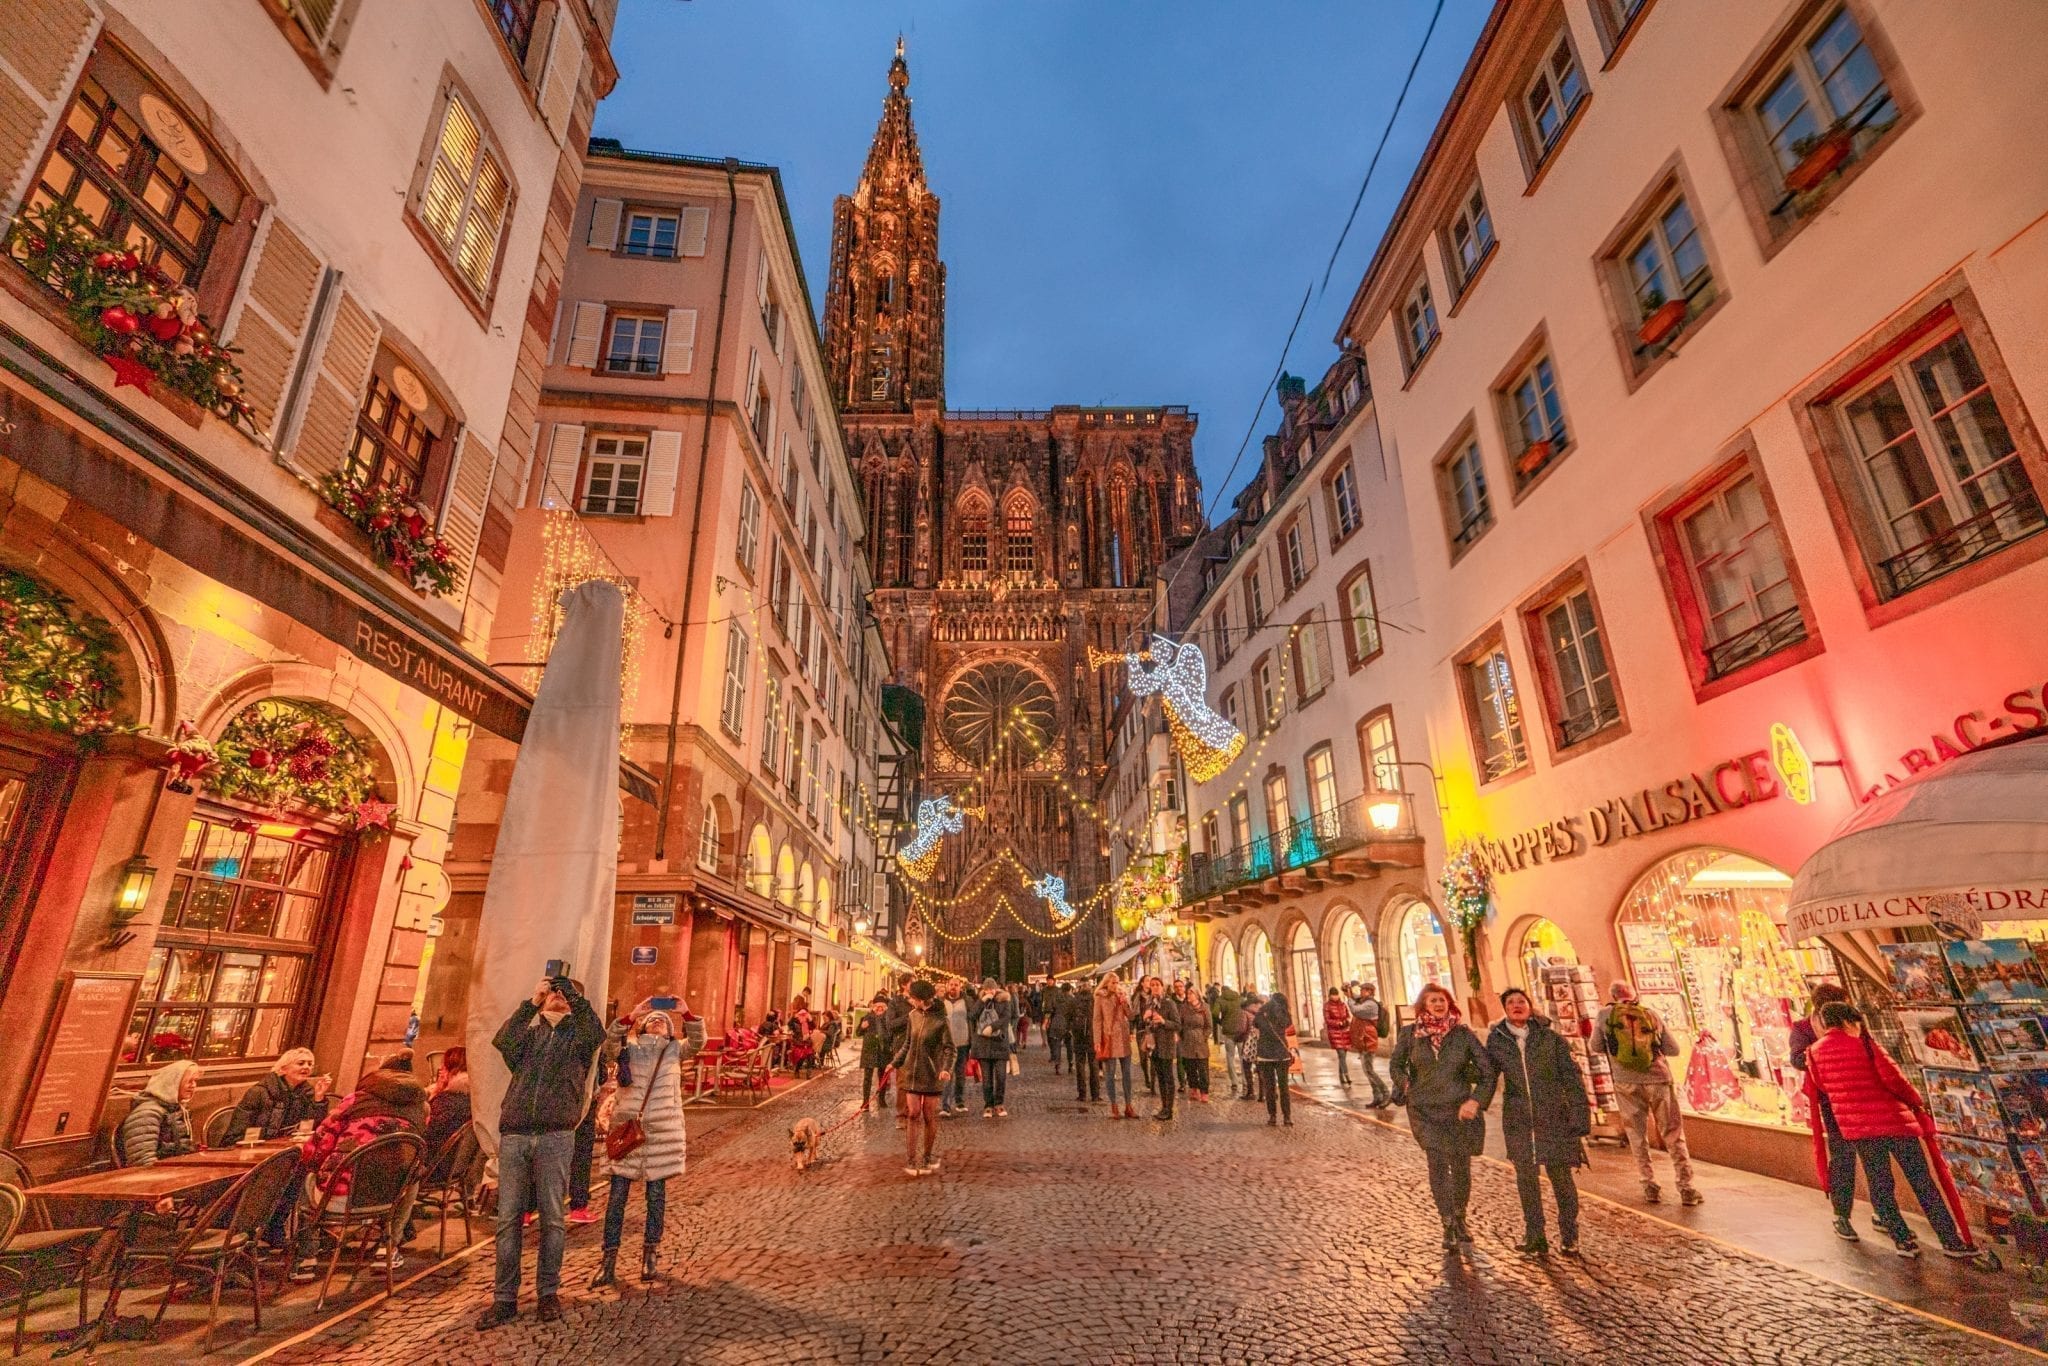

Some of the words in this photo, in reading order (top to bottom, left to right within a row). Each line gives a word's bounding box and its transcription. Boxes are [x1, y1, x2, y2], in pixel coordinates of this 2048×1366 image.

[356, 621, 487, 715] RESTAURANT
[1861, 681, 2048, 804] TBAC-S
[1476, 816, 1576, 875] NAPPES
[1584, 750, 1779, 847] D'ALSACE
[1827, 906, 1850, 923] DE
[1854, 901, 1880, 920] LA
[1883, 887, 2048, 917] CAÉDR
